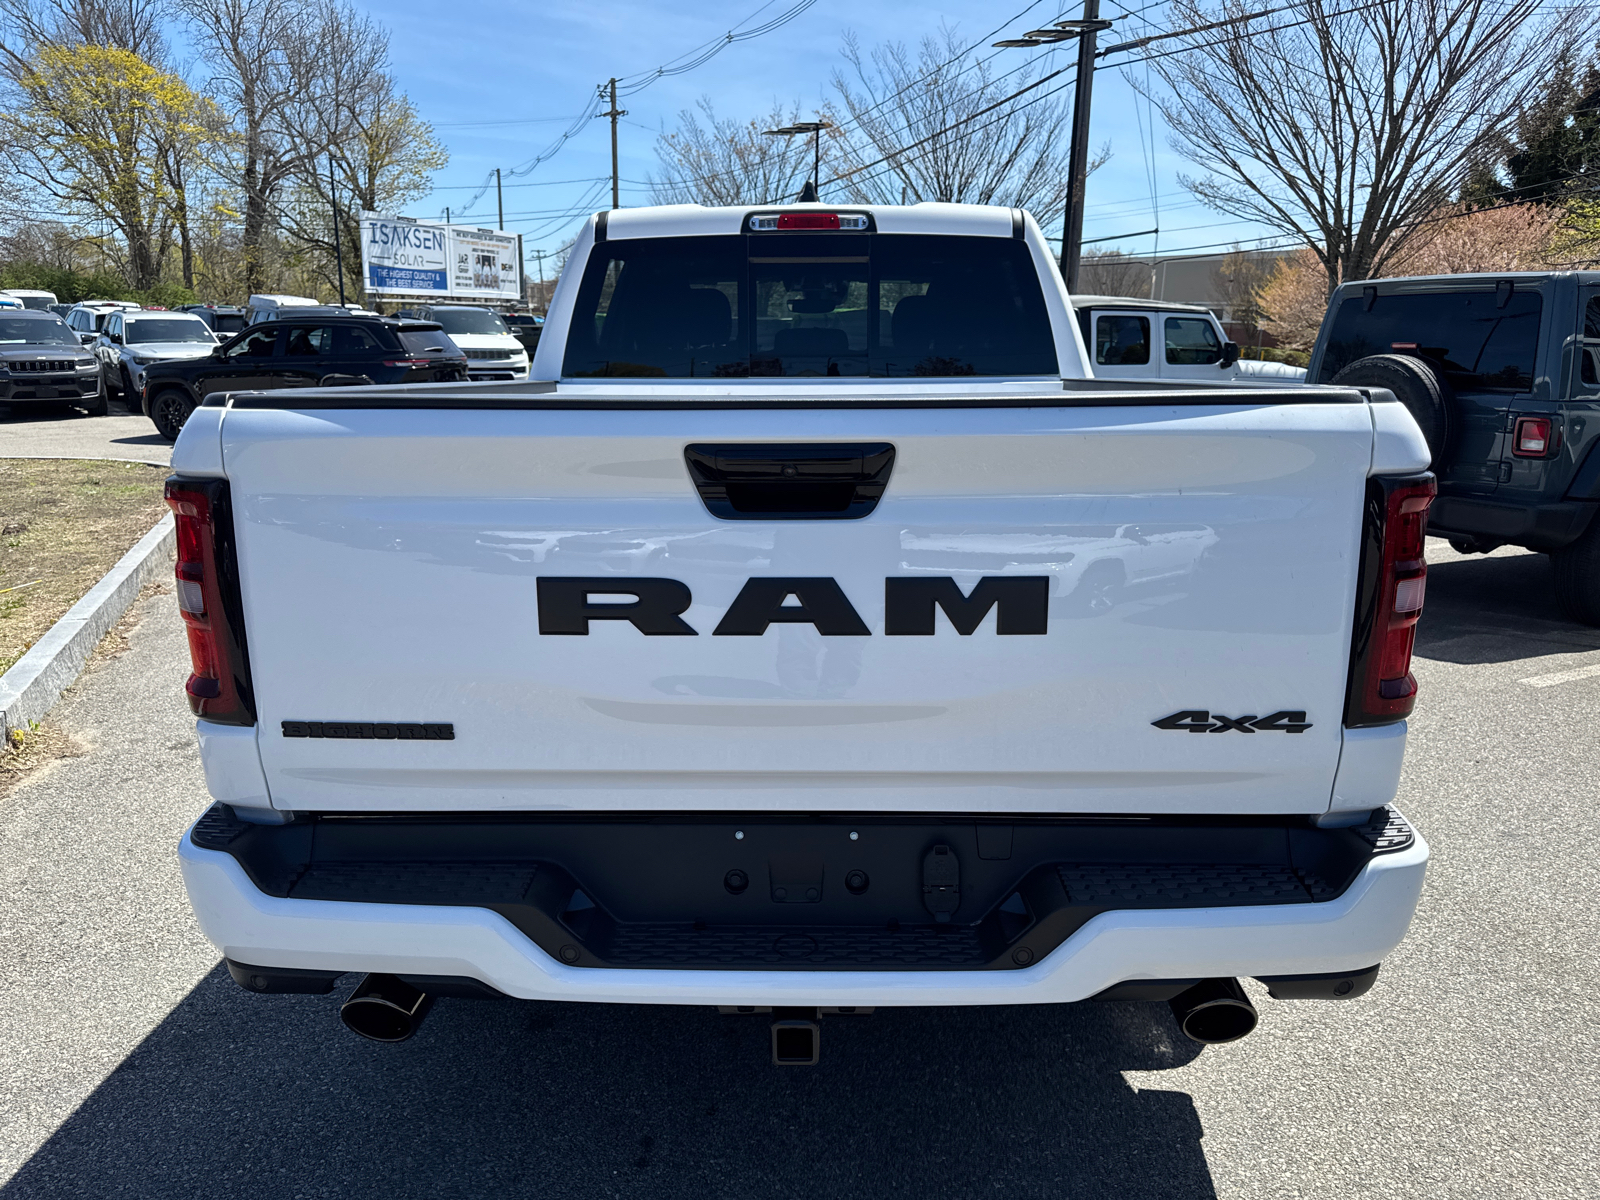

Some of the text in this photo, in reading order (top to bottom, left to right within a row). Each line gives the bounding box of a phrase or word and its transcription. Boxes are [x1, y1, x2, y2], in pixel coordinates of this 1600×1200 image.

[369, 222, 443, 251] ISAKSEN
[393, 253, 424, 267] SOLAR
[377, 268, 440, 281] THE HIGHEST QUALITY &
[385, 278, 435, 289] THE BEST SERVICE
[536, 576, 1050, 636] RAM
